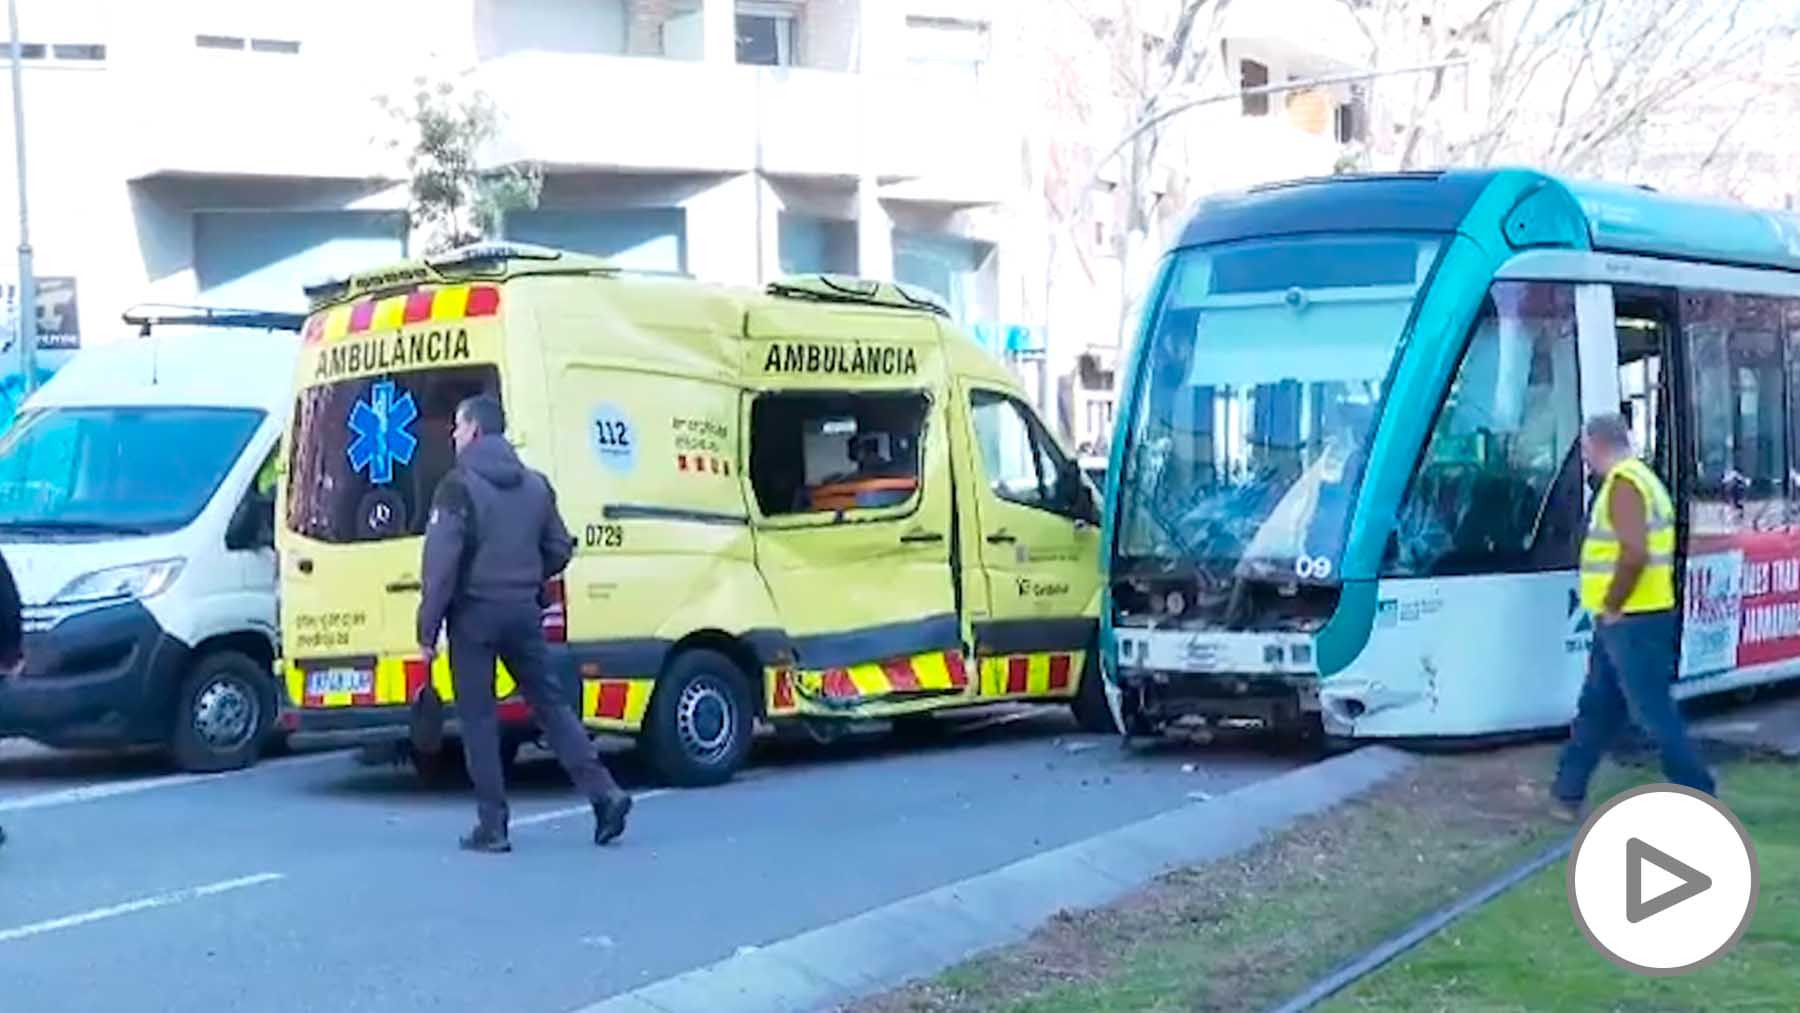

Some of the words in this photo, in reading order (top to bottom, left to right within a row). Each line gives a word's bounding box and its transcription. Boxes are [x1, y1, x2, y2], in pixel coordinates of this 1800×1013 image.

[316, 329, 470, 378] AMBULÀNCIA
[764, 339, 917, 375] AMBULÀNCIA
[596, 420, 630, 446] 112
[1295, 555, 1332, 579] 09
